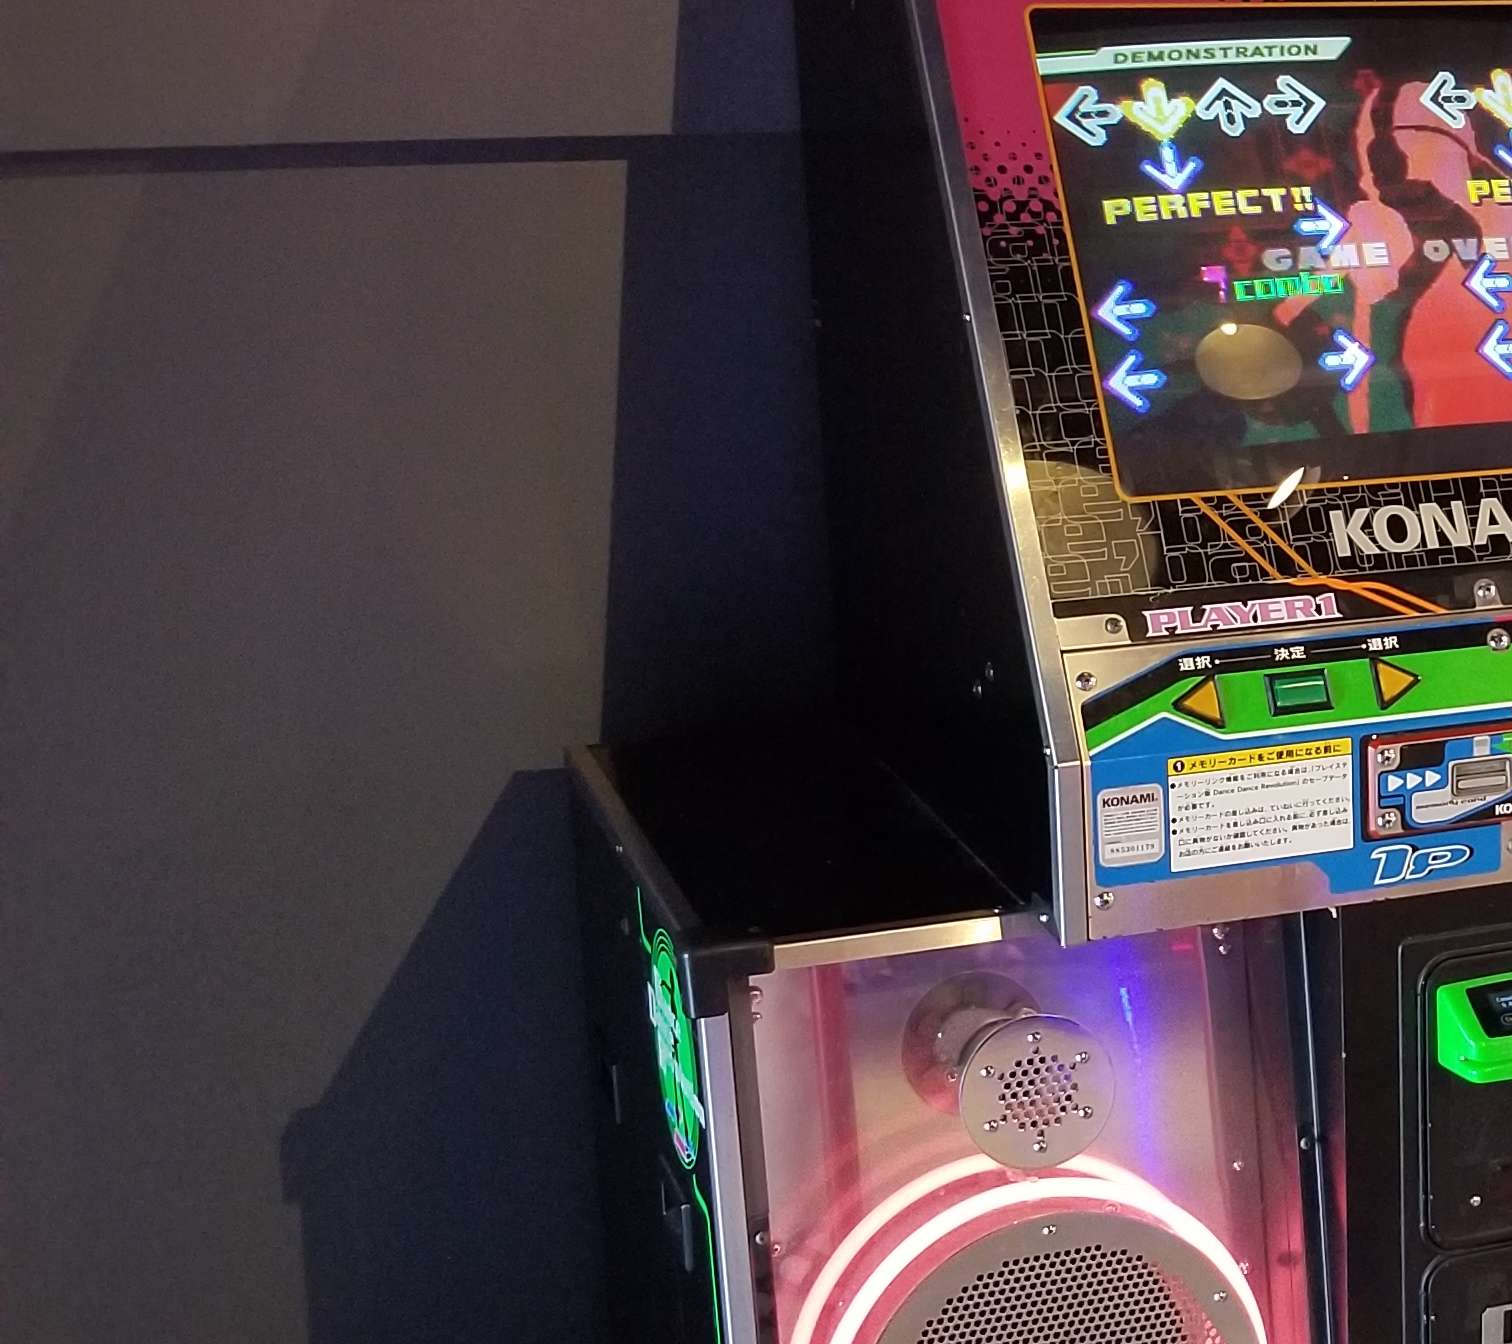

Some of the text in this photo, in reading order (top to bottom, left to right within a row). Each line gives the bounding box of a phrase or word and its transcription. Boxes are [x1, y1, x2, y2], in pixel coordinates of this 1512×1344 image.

[1112, 43, 1319, 66] DEMONSTRATION
[1101, 186, 1314, 226] PERFECT!!
[1261, 240, 1390, 272] GAME
[1231, 272, 1345, 302] combo
[1178, 636, 1400, 672] 選択 決定 選択
[1102, 792, 1156, 808] KONAMI
